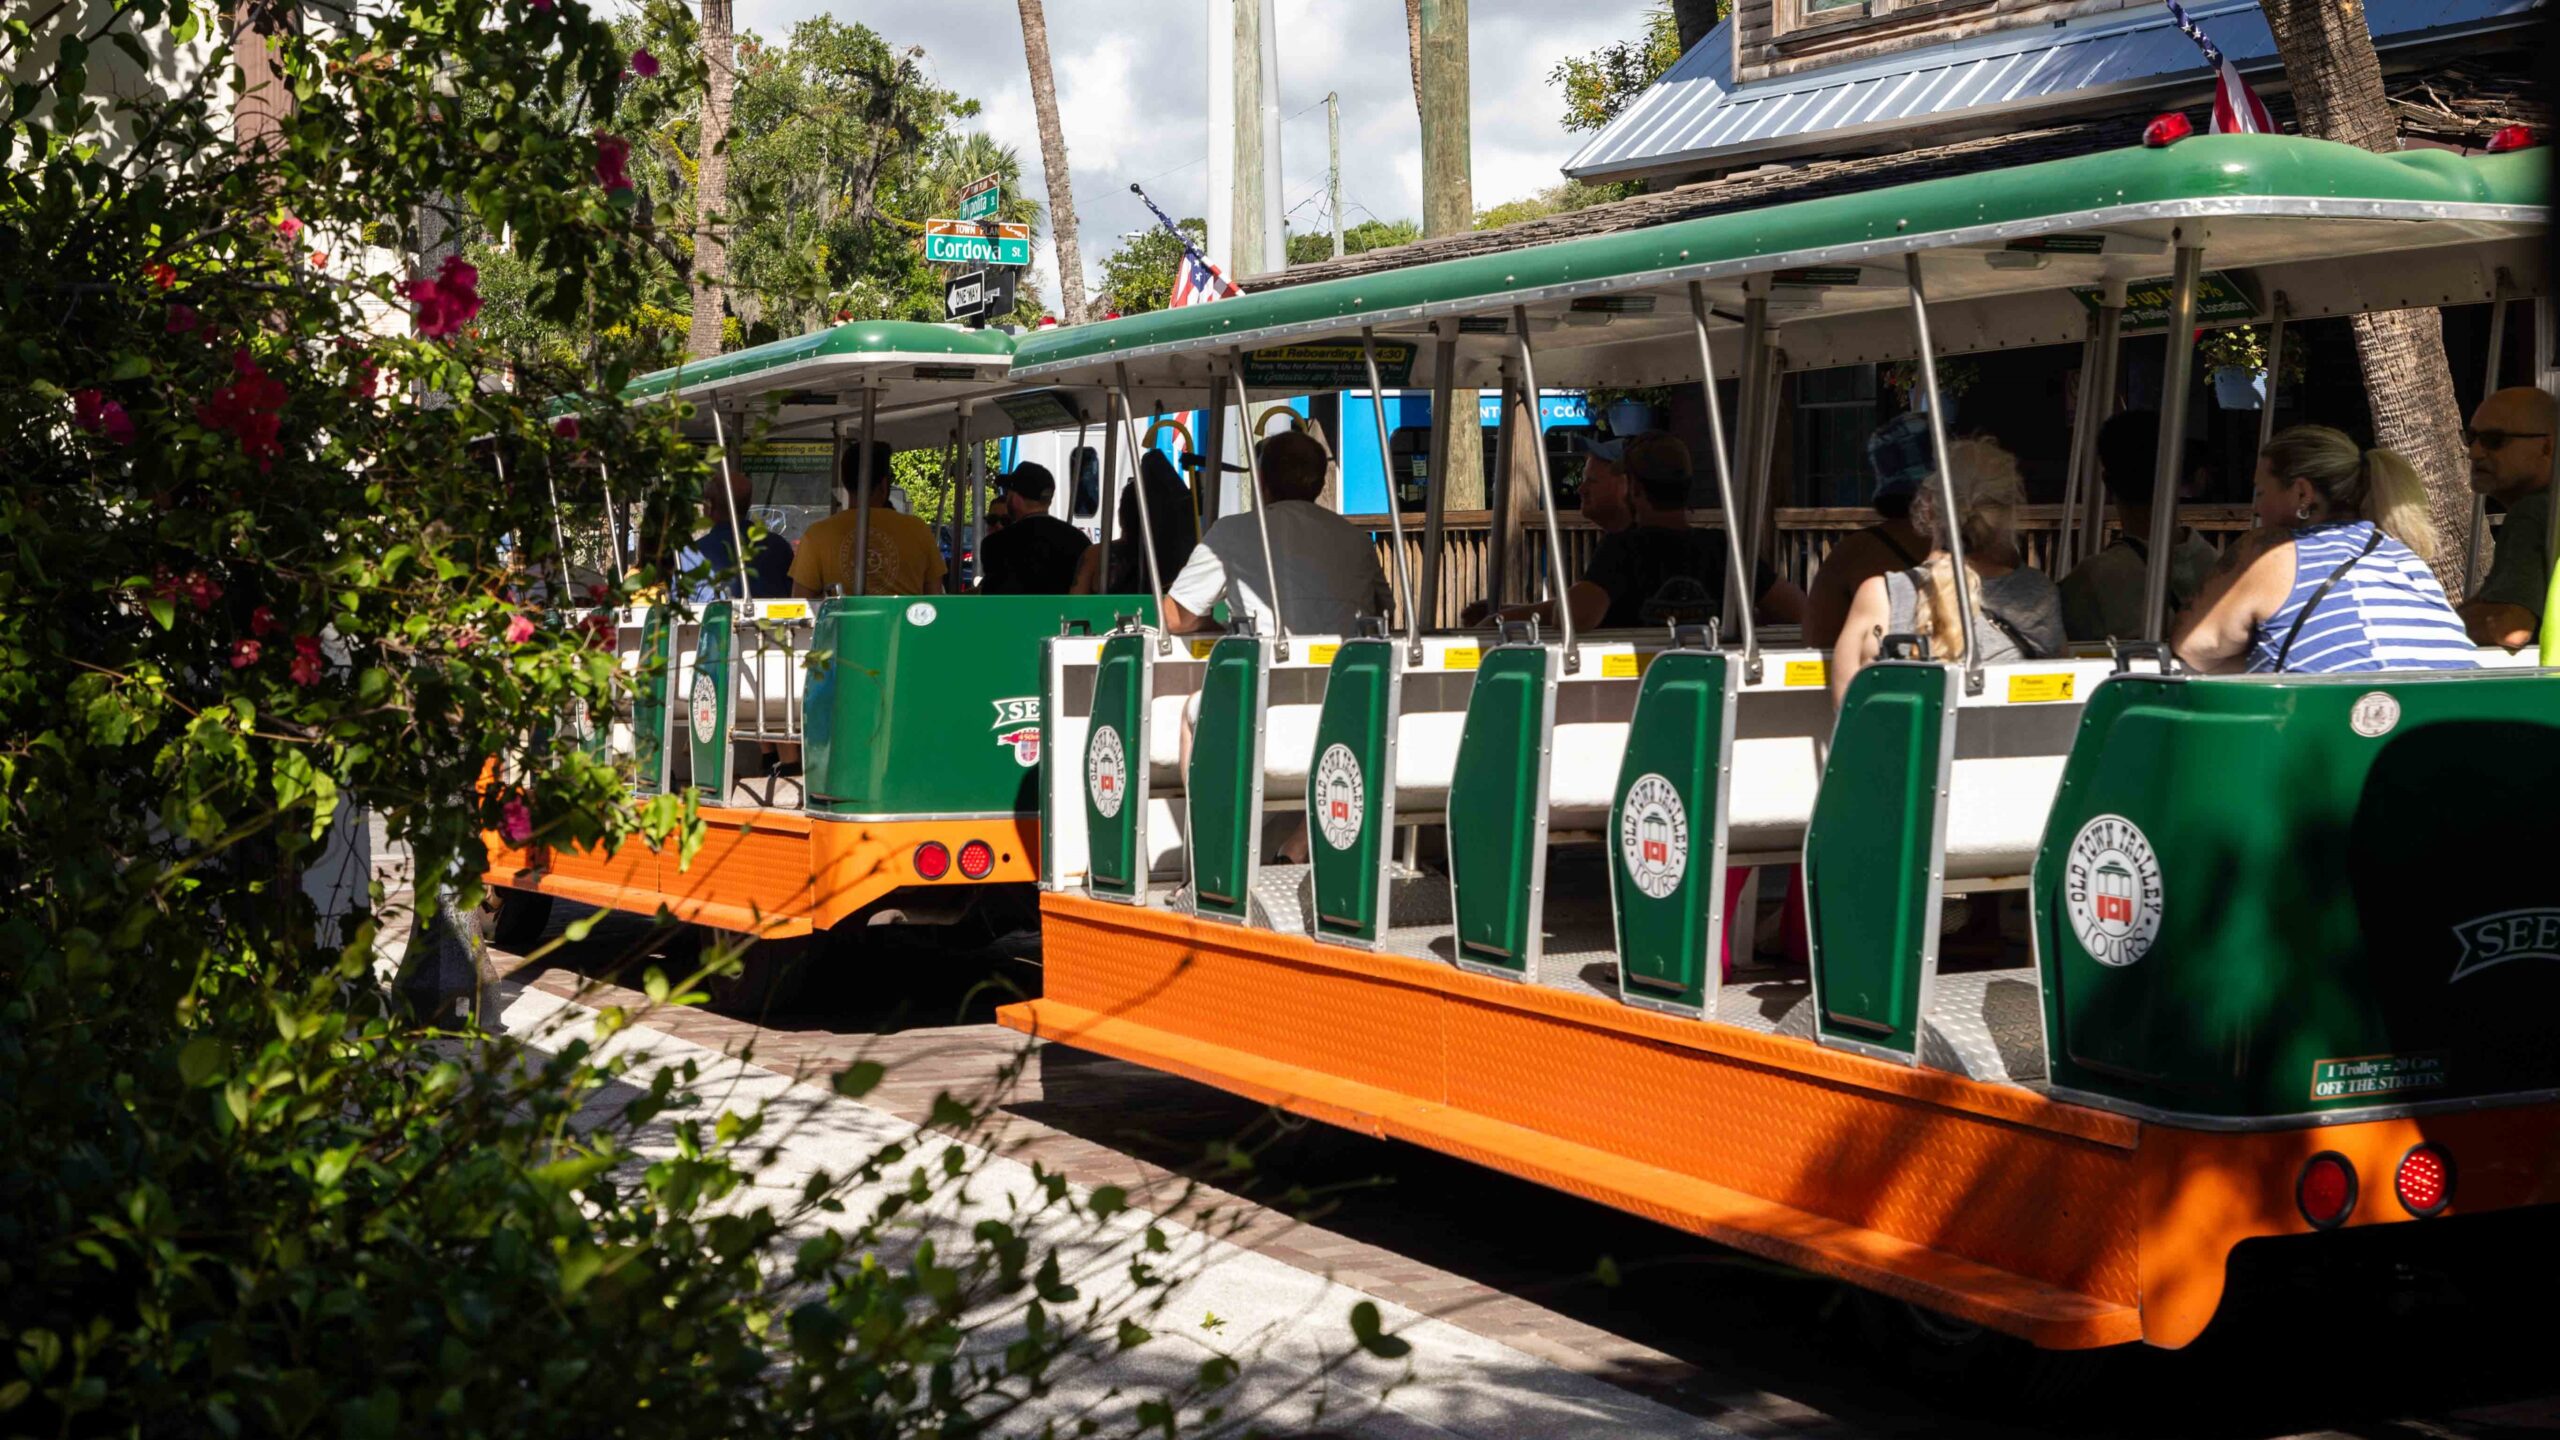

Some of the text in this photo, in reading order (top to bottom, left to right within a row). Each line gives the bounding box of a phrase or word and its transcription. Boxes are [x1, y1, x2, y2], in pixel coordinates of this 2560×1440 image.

[955, 224, 999, 236] TOWN PLAN
[934, 238, 1001, 260] Cordova
[956, 285, 979, 305] ONE WAY
[1257, 349, 1283, 358] Last
[1287, 347, 1356, 361] Reboarding
[1376, 349, 1402, 359] 4:30
[1008, 701, 1040, 719] SE
[1090, 758, 1098, 781] OLD
[1318, 779, 1327, 806] OLD
[1343, 752, 1363, 813] TROLLEY
[1625, 781, 1686, 856] OLD TOWN TROLLEY
[1324, 820, 1357, 849] TOURS
[1634, 858, 1680, 896] TOURS
[2070, 822, 2162, 916] OLD TOWN TROLLEY
[2082, 916, 2150, 964] TOURS
[2475, 915, 2560, 959] SEE
[2327, 1064, 2335, 1078] 1
[2338, 1061, 2379, 1077] Trolley
[2393, 1058, 2408, 1072] 20
[2411, 1056, 2439, 1070] Cars
[2316, 1080, 2345, 1096] OFF
[2347, 1077, 2377, 1093] THE
